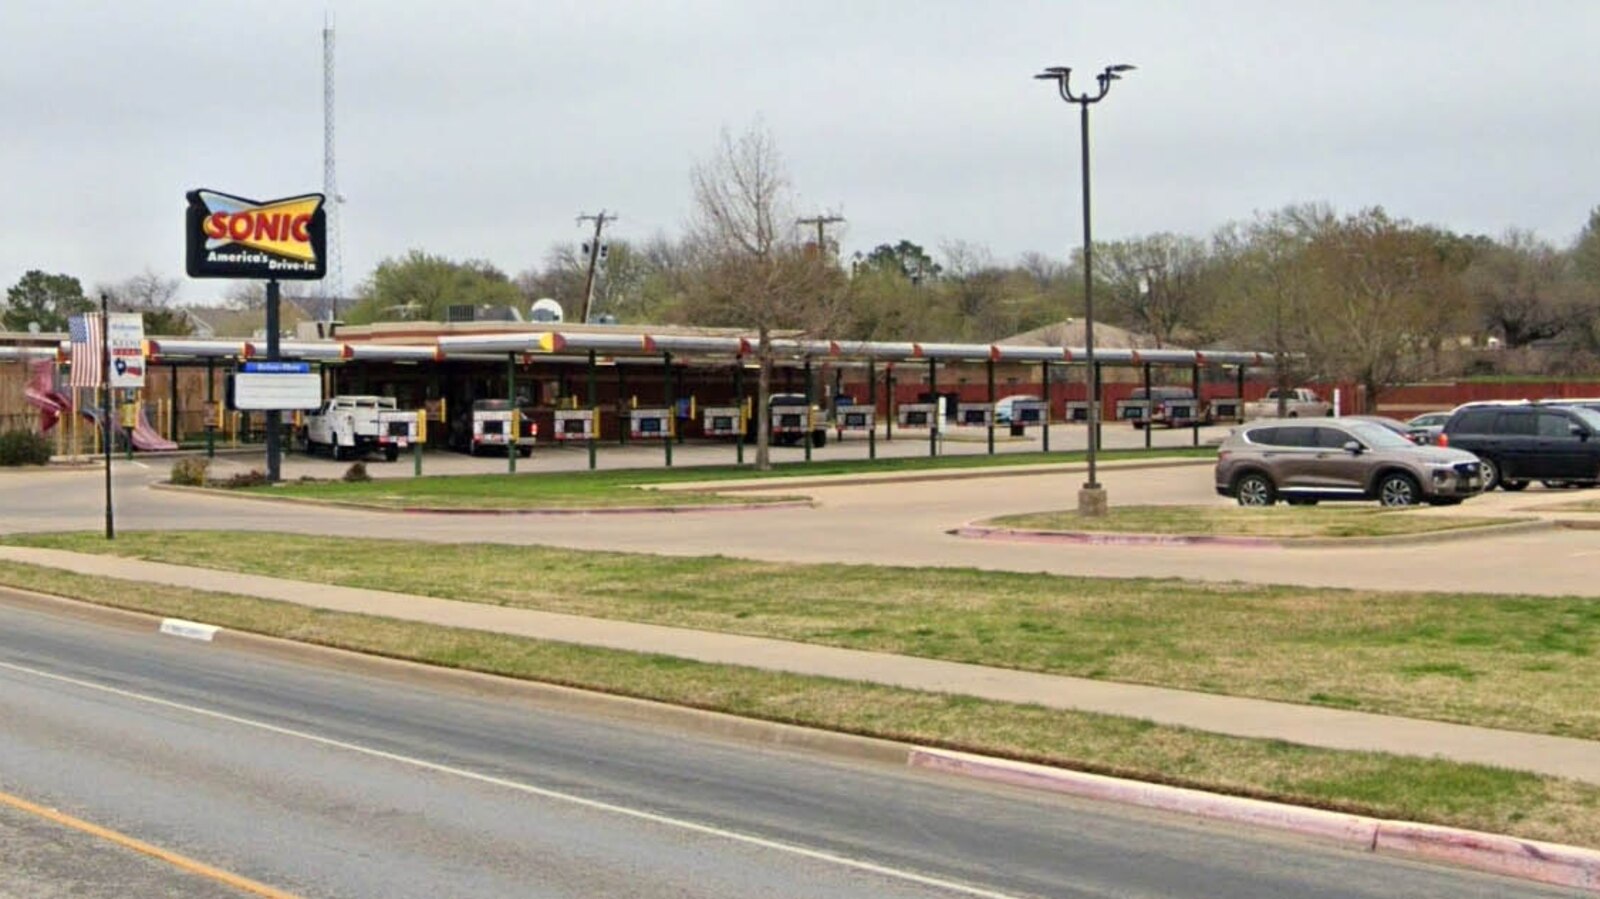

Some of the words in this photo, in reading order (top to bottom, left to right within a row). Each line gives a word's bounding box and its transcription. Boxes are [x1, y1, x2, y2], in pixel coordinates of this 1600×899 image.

[208, 211, 313, 242] SONIC
[207, 251, 268, 263] America's
[268, 260, 316, 271] Drive-In
